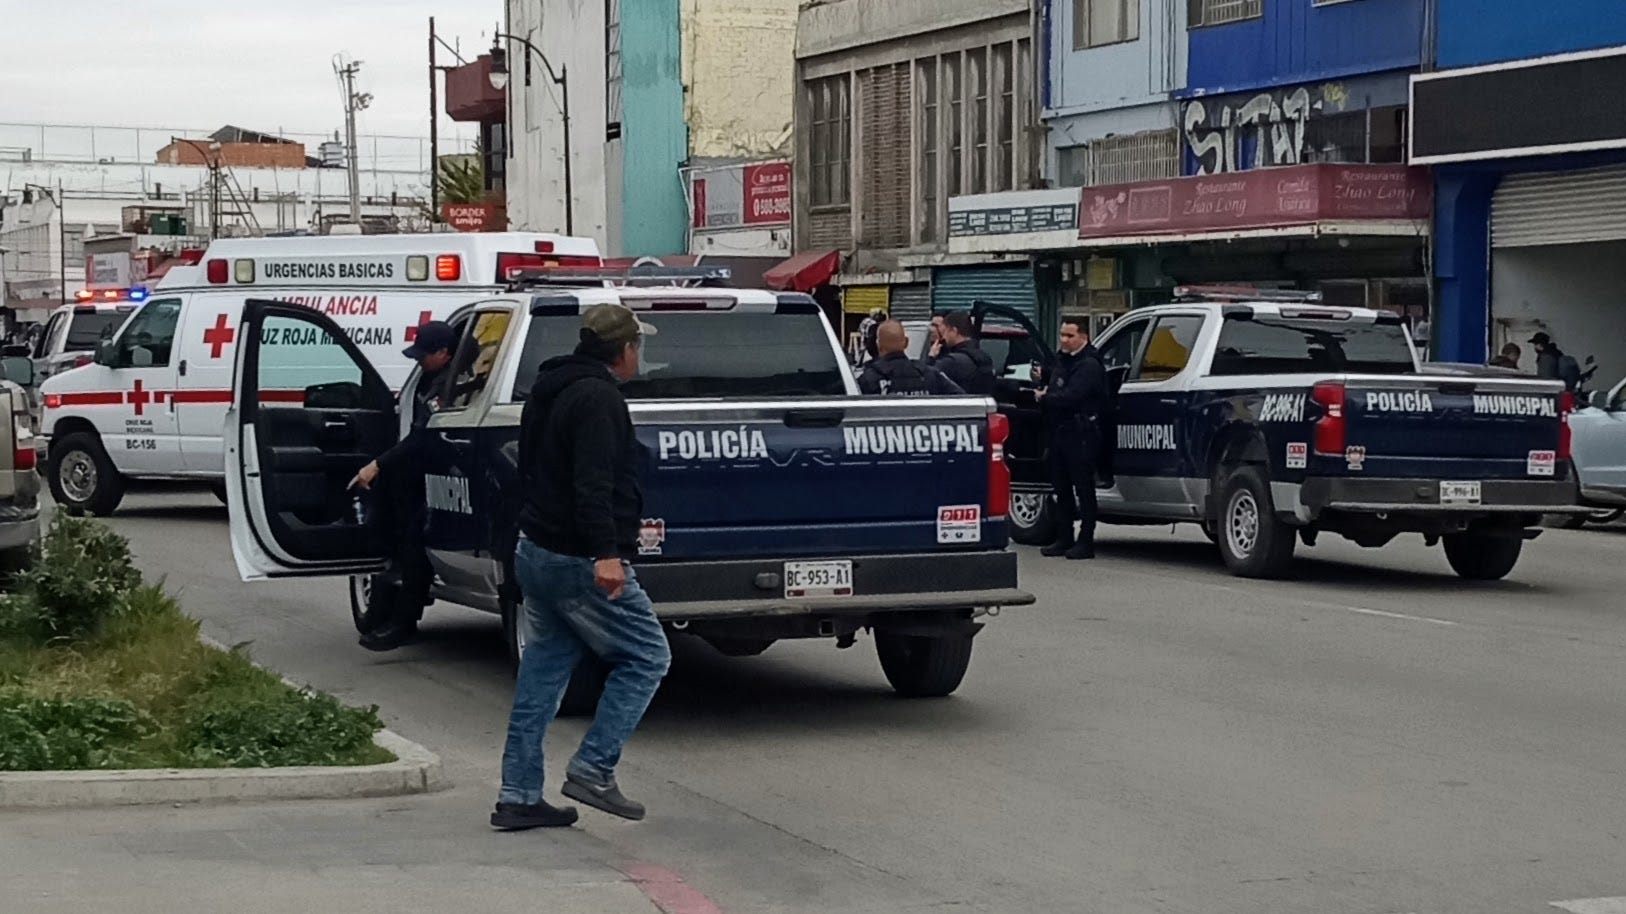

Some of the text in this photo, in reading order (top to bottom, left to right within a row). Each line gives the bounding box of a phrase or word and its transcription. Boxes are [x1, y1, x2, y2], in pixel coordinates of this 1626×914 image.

[449, 207, 486, 217] BORDER
[1183, 197, 1213, 215] Zhao
[1216, 198, 1247, 218] Long
[265, 262, 394, 279] URGENCIAS BASICAS
[281, 327, 317, 346] ROJA
[1366, 390, 1558, 418] POLICÍA MUNICIPAL
[126, 439, 157, 450] BC-156
[658, 424, 985, 460] POLICÍA MUNICIPAL
[1117, 424, 1177, 450] MUNICIPAL
[942, 510, 976, 521] 911
[787, 569, 850, 587] BC-953-A1
